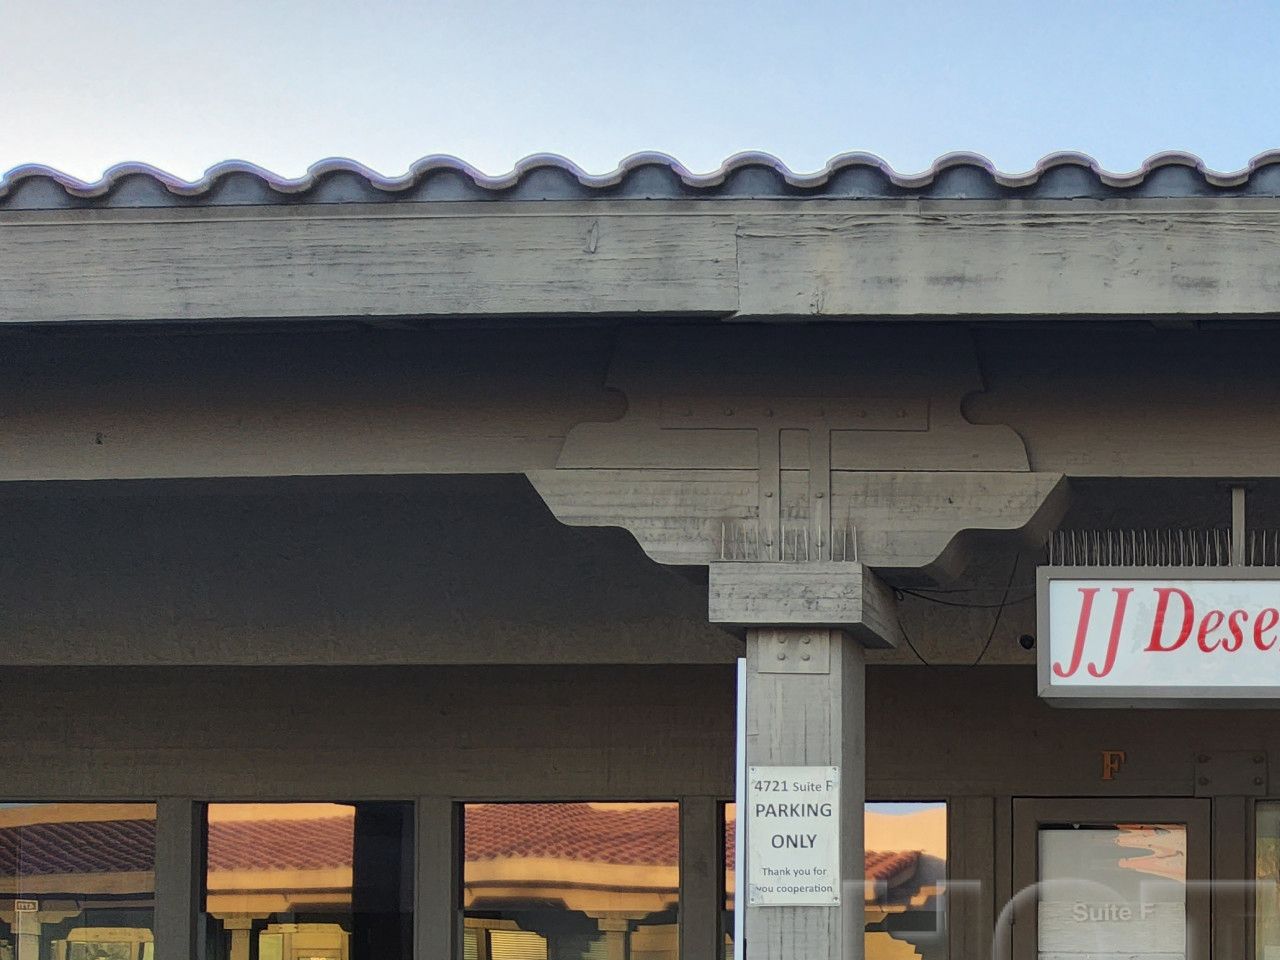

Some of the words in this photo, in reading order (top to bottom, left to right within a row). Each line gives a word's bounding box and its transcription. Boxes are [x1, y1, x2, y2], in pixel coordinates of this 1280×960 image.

[1053, 587, 1133, 679] JJ
[1101, 751, 1126, 780] F
[754, 780, 789, 792] 4721
[792, 781, 822, 792] Suite
[825, 780, 833, 792] F
[755, 803, 833, 818] PARKING
[771, 834, 818, 849] ONLY
[762, 867, 791, 876] Thank
[792, 868, 811, 878] you
[813, 867, 827, 876] for
[776, 885, 833, 895] cooperation
[1072, 903, 1132, 922] Suite
[1140, 903, 1154, 921] F
